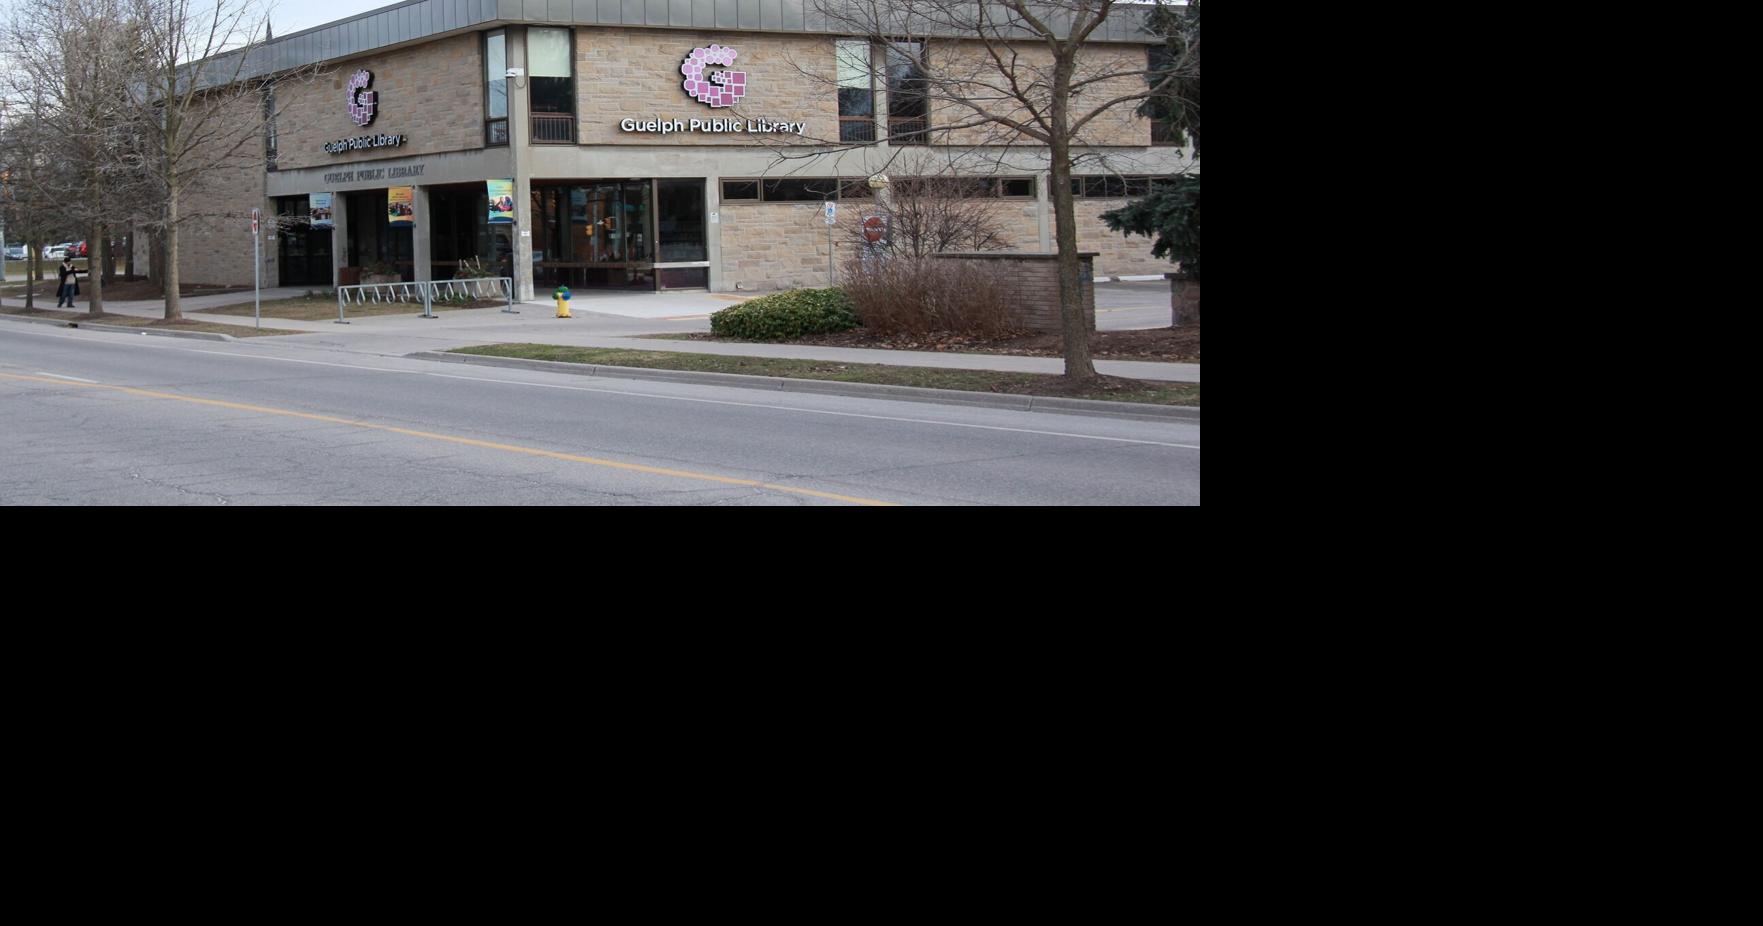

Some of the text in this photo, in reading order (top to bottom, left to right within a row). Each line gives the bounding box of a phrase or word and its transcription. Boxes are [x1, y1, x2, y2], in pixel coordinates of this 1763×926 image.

[621, 118, 807, 134] Guelph Public Library
[324, 133, 401, 154] Guelph Public Library
[324, 164, 425, 184] GUELPH PUBLIC LIBRARY
